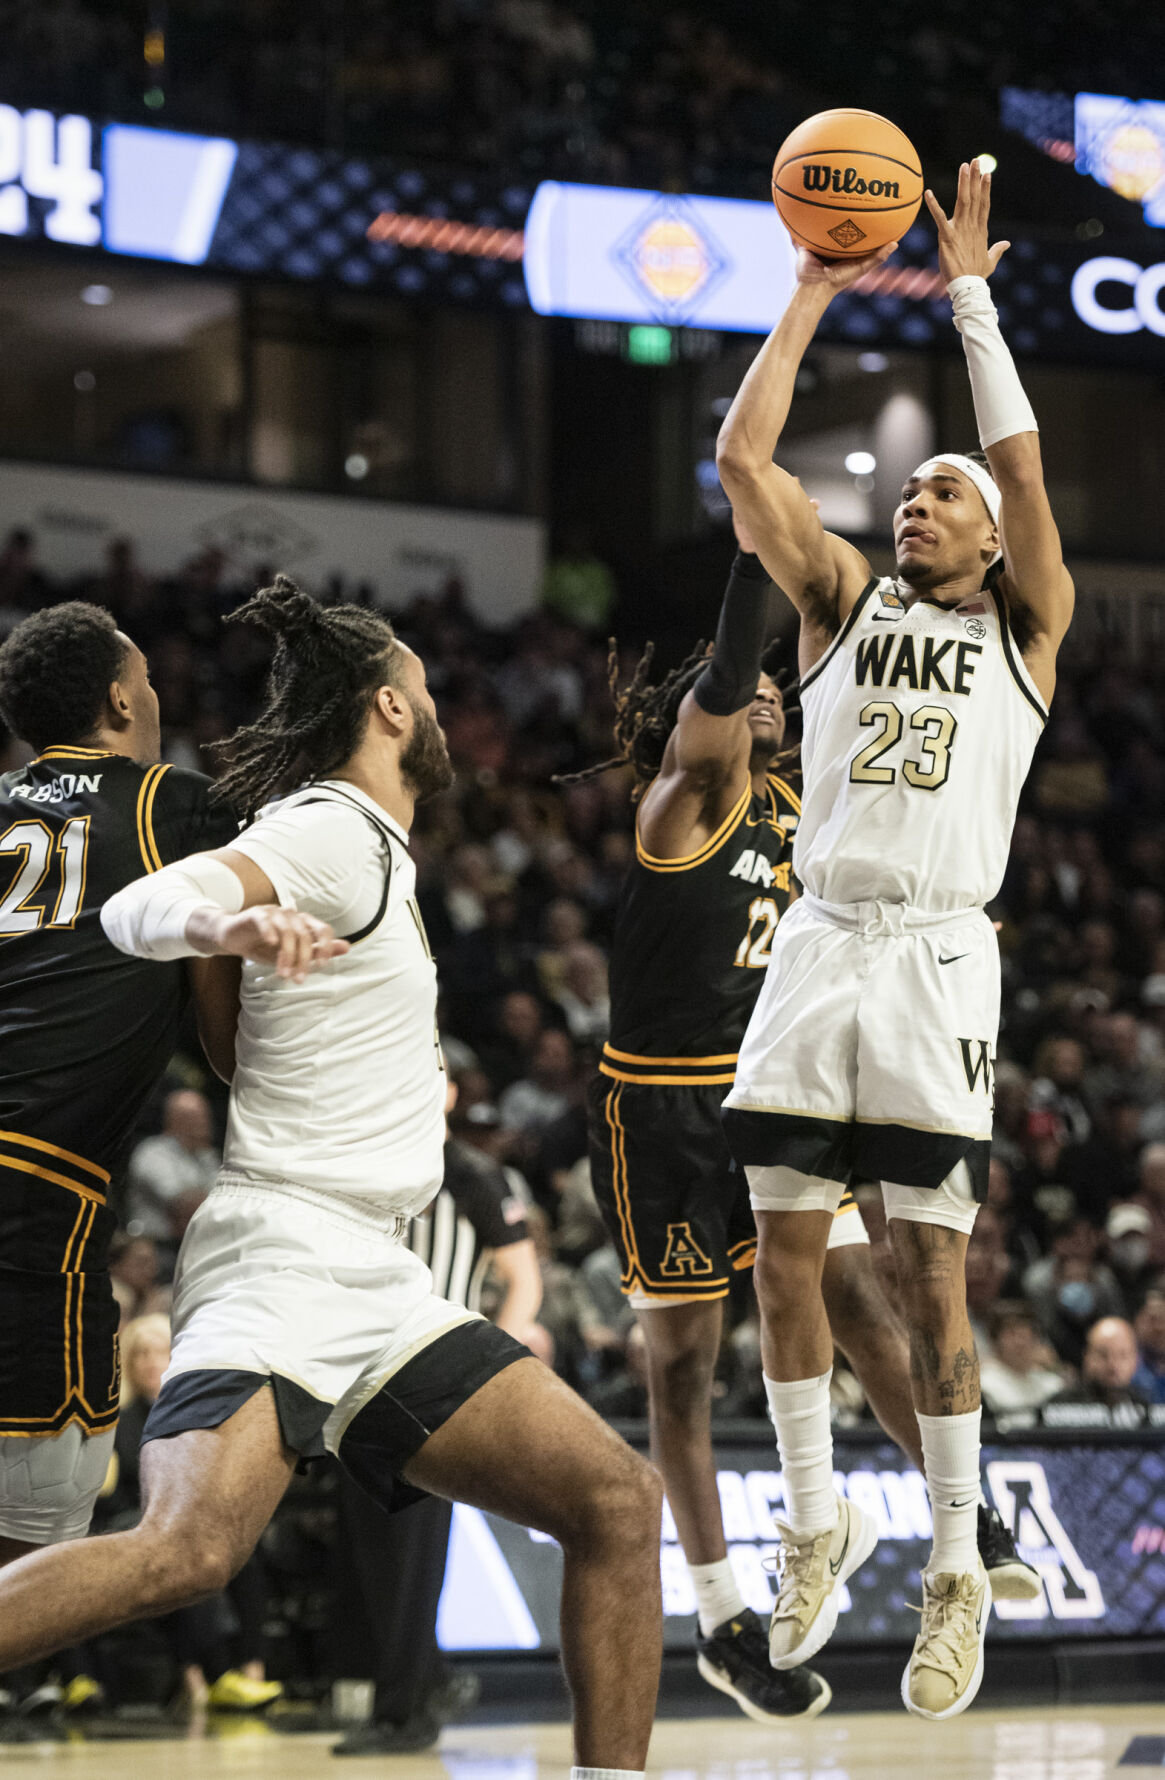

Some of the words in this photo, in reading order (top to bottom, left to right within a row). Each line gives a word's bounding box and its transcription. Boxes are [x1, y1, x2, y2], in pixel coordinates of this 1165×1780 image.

[802, 165, 900, 199] Wilson
[855, 633, 983, 696] WAKE
[849, 701, 958, 792] 23
[9, 774, 103, 803] ABSON
[0, 815, 91, 938] 21
[659, 1221, 713, 1276] A
[986, 1461, 1105, 1619] A
